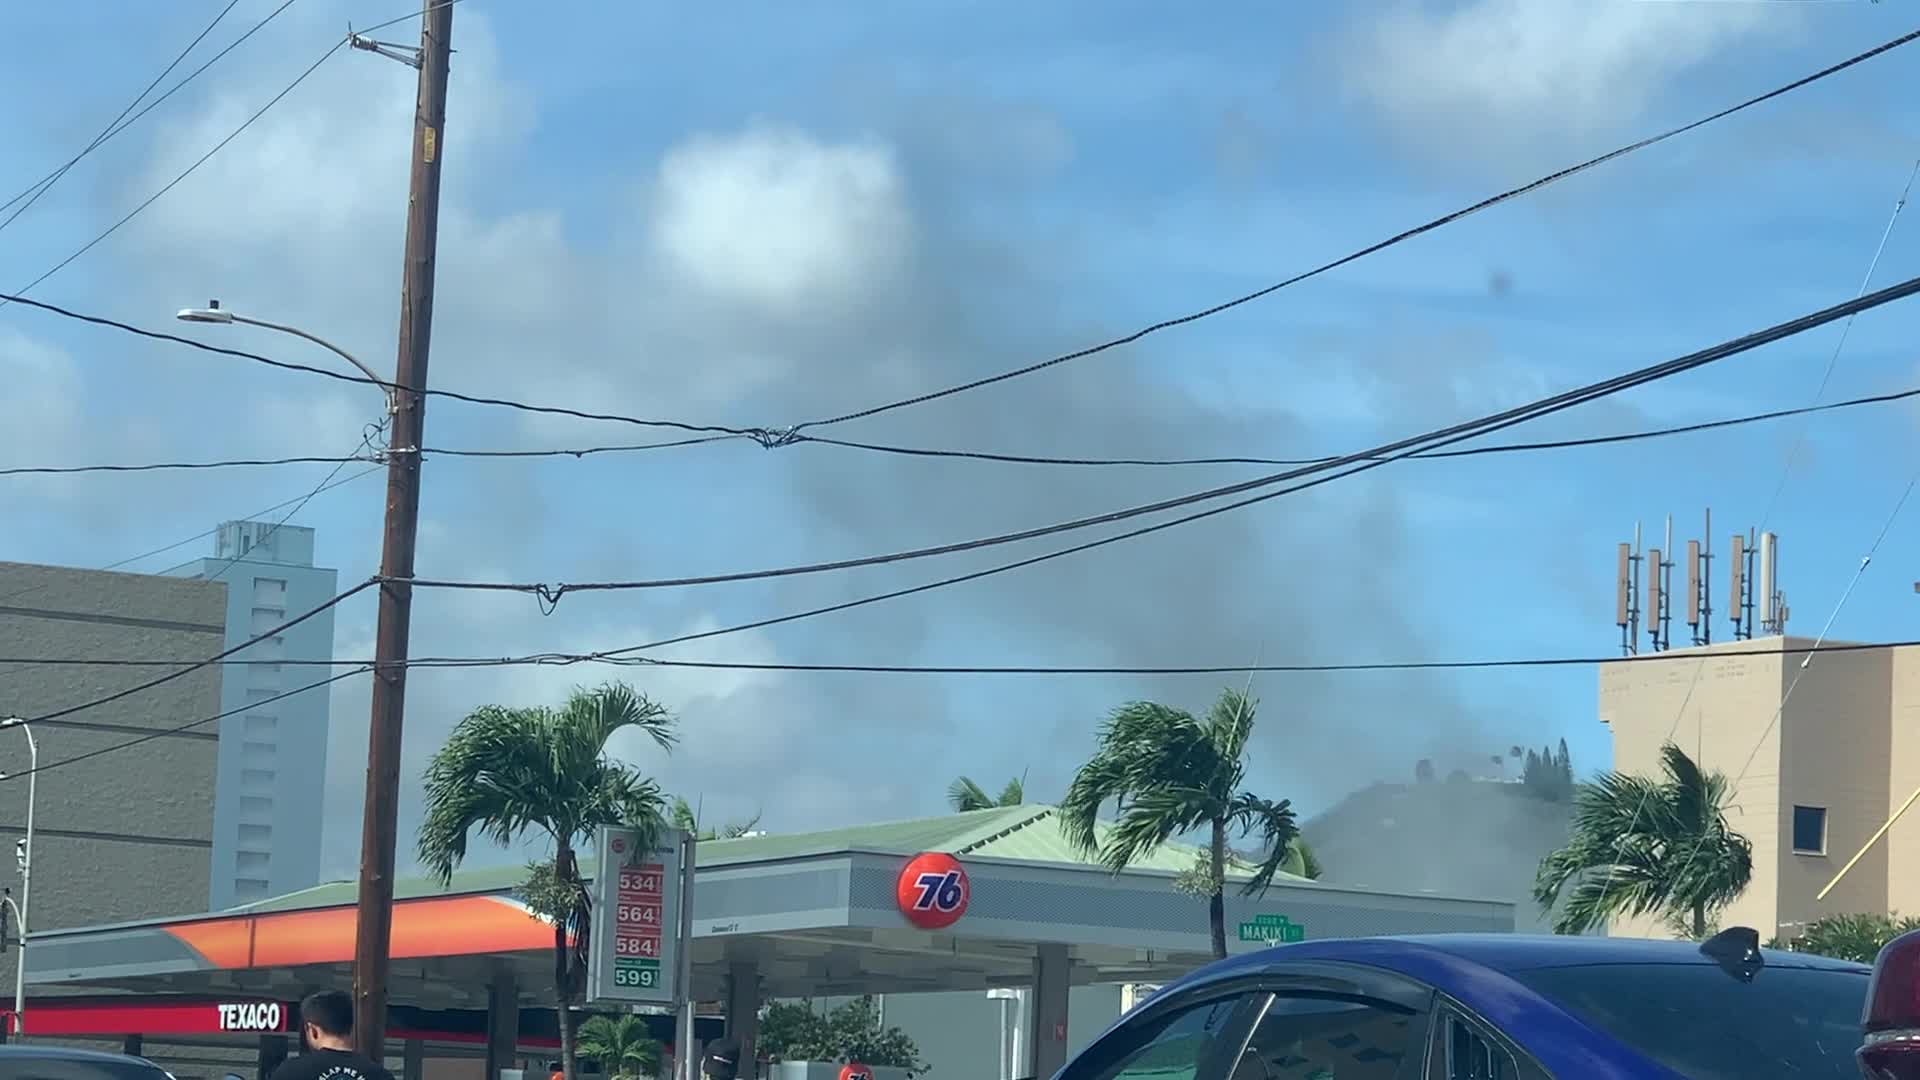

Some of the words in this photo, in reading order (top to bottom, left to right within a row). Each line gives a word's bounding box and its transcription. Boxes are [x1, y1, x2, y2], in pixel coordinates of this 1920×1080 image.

[619, 873, 655, 891] 534
[913, 870, 963, 912] 76
[618, 905, 655, 923] 564
[1243, 925, 1287, 940] MAKIKI
[616, 937, 653, 955] 584
[615, 969, 653, 986] 599
[218, 1003, 280, 1030] TEXACO
